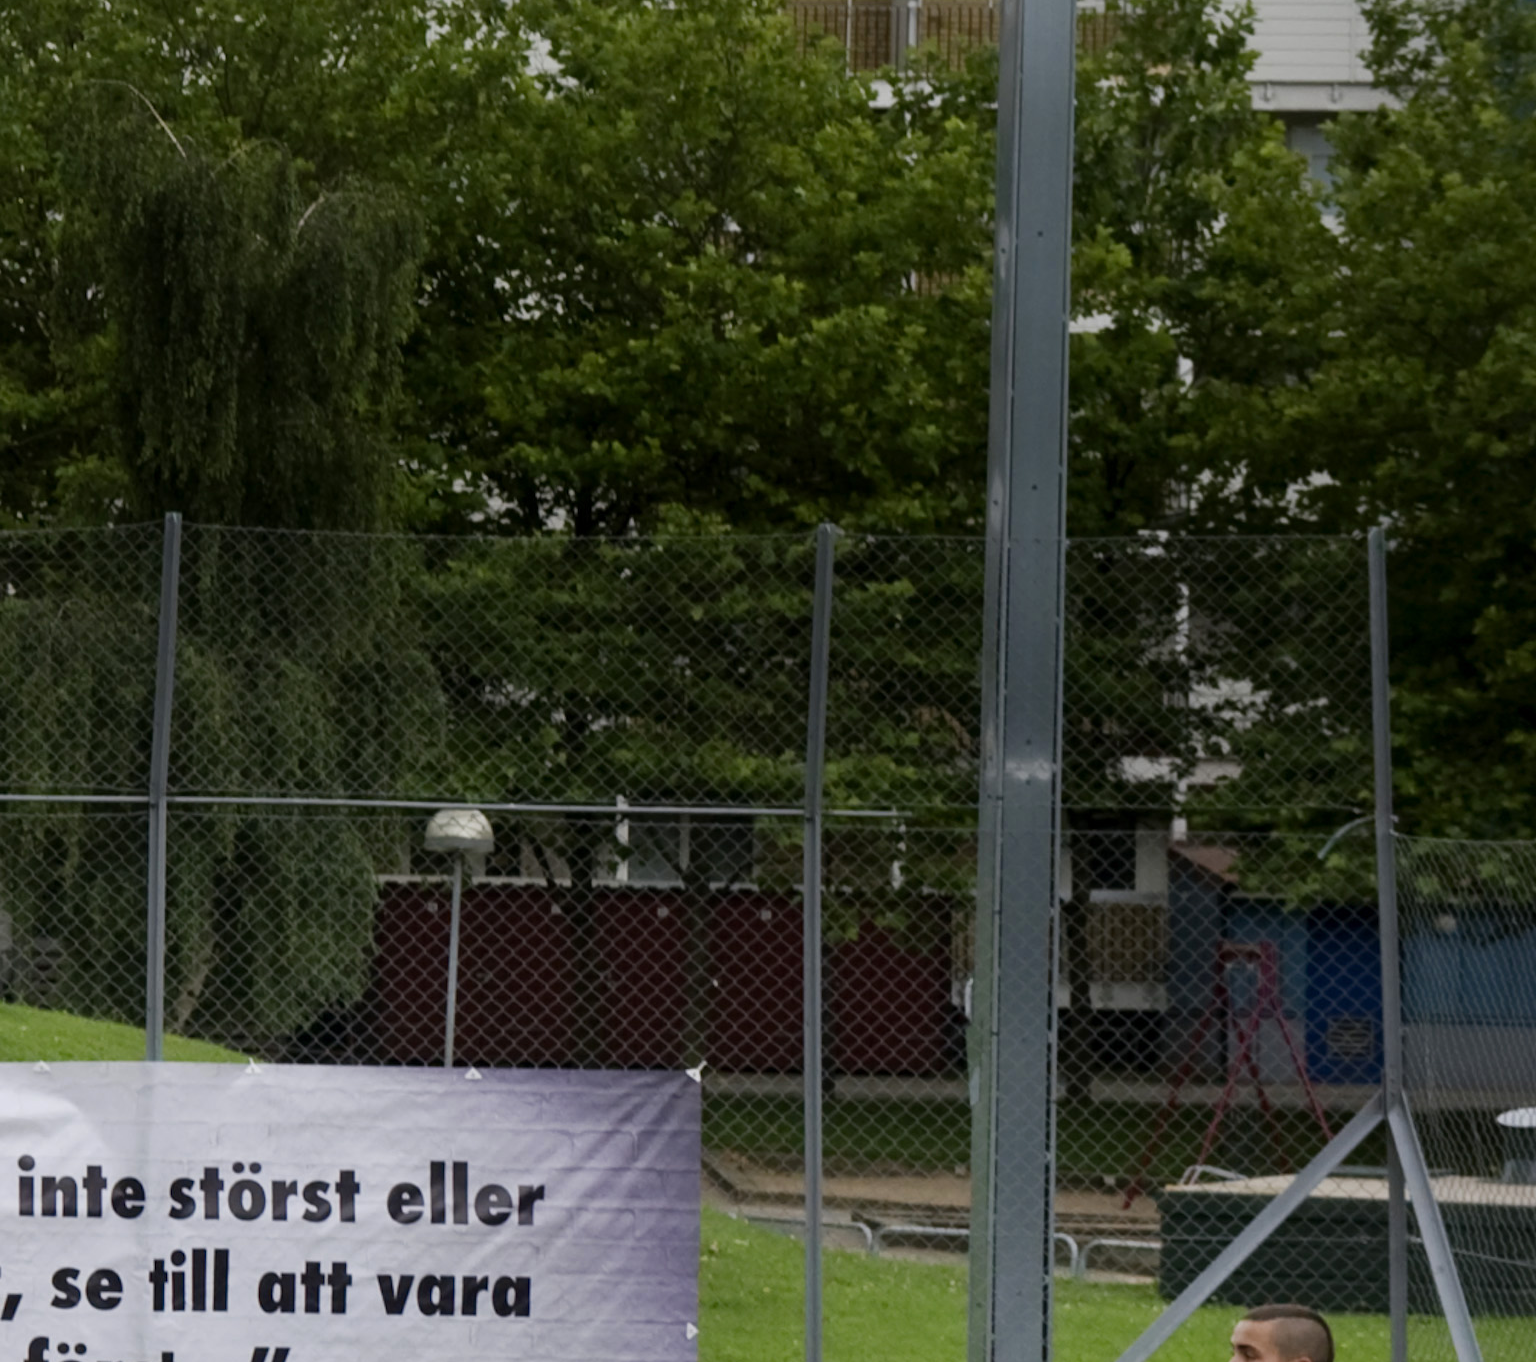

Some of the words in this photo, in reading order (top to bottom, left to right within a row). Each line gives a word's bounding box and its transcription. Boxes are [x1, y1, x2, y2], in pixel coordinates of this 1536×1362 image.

[18, 1156, 147, 1221] inte
[168, 1162, 361, 1224] störst
[387, 1160, 547, 1228] eller
[51, 1267, 124, 1312] se
[148, 1248, 231, 1313] till
[258, 1261, 354, 1316] att
[376, 1274, 532, 1319] vara
